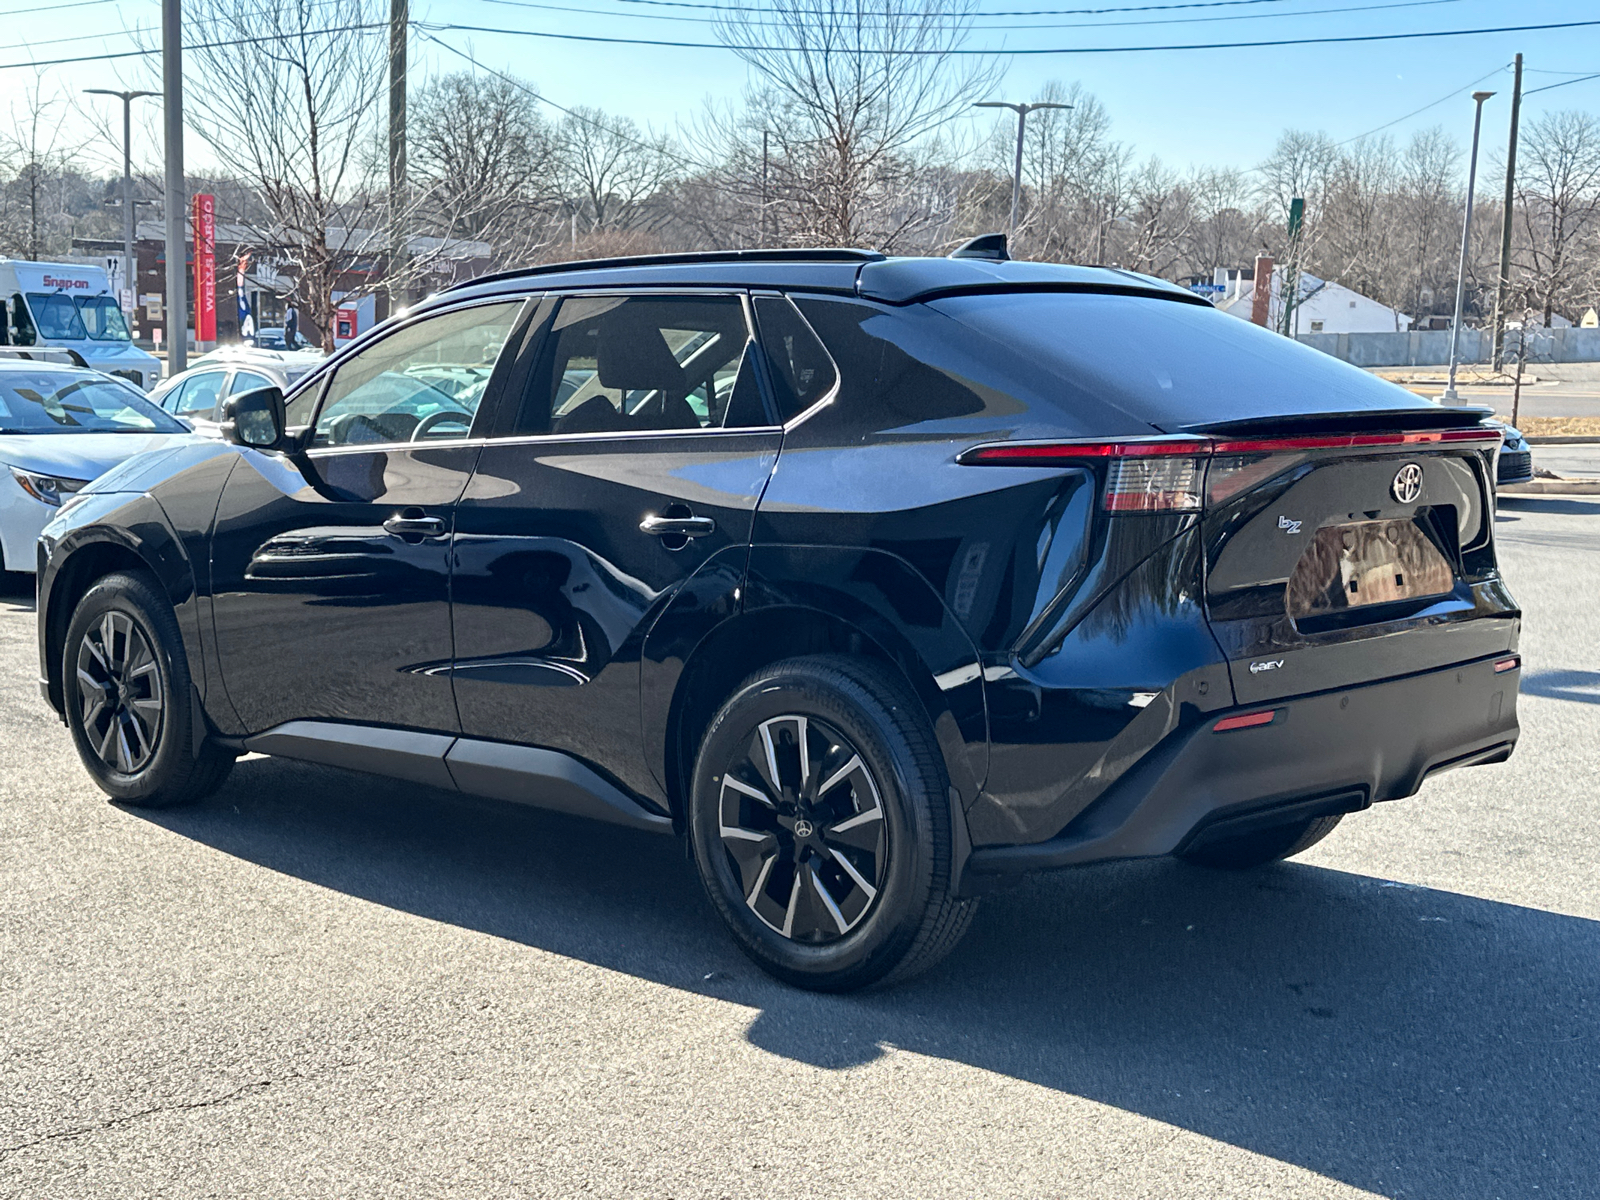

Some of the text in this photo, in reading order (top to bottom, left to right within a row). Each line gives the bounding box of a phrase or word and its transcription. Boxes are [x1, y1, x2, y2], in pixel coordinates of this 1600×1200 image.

[43, 275, 89, 290] Snap-on
[204, 200, 213, 312] WELLS FARGO
